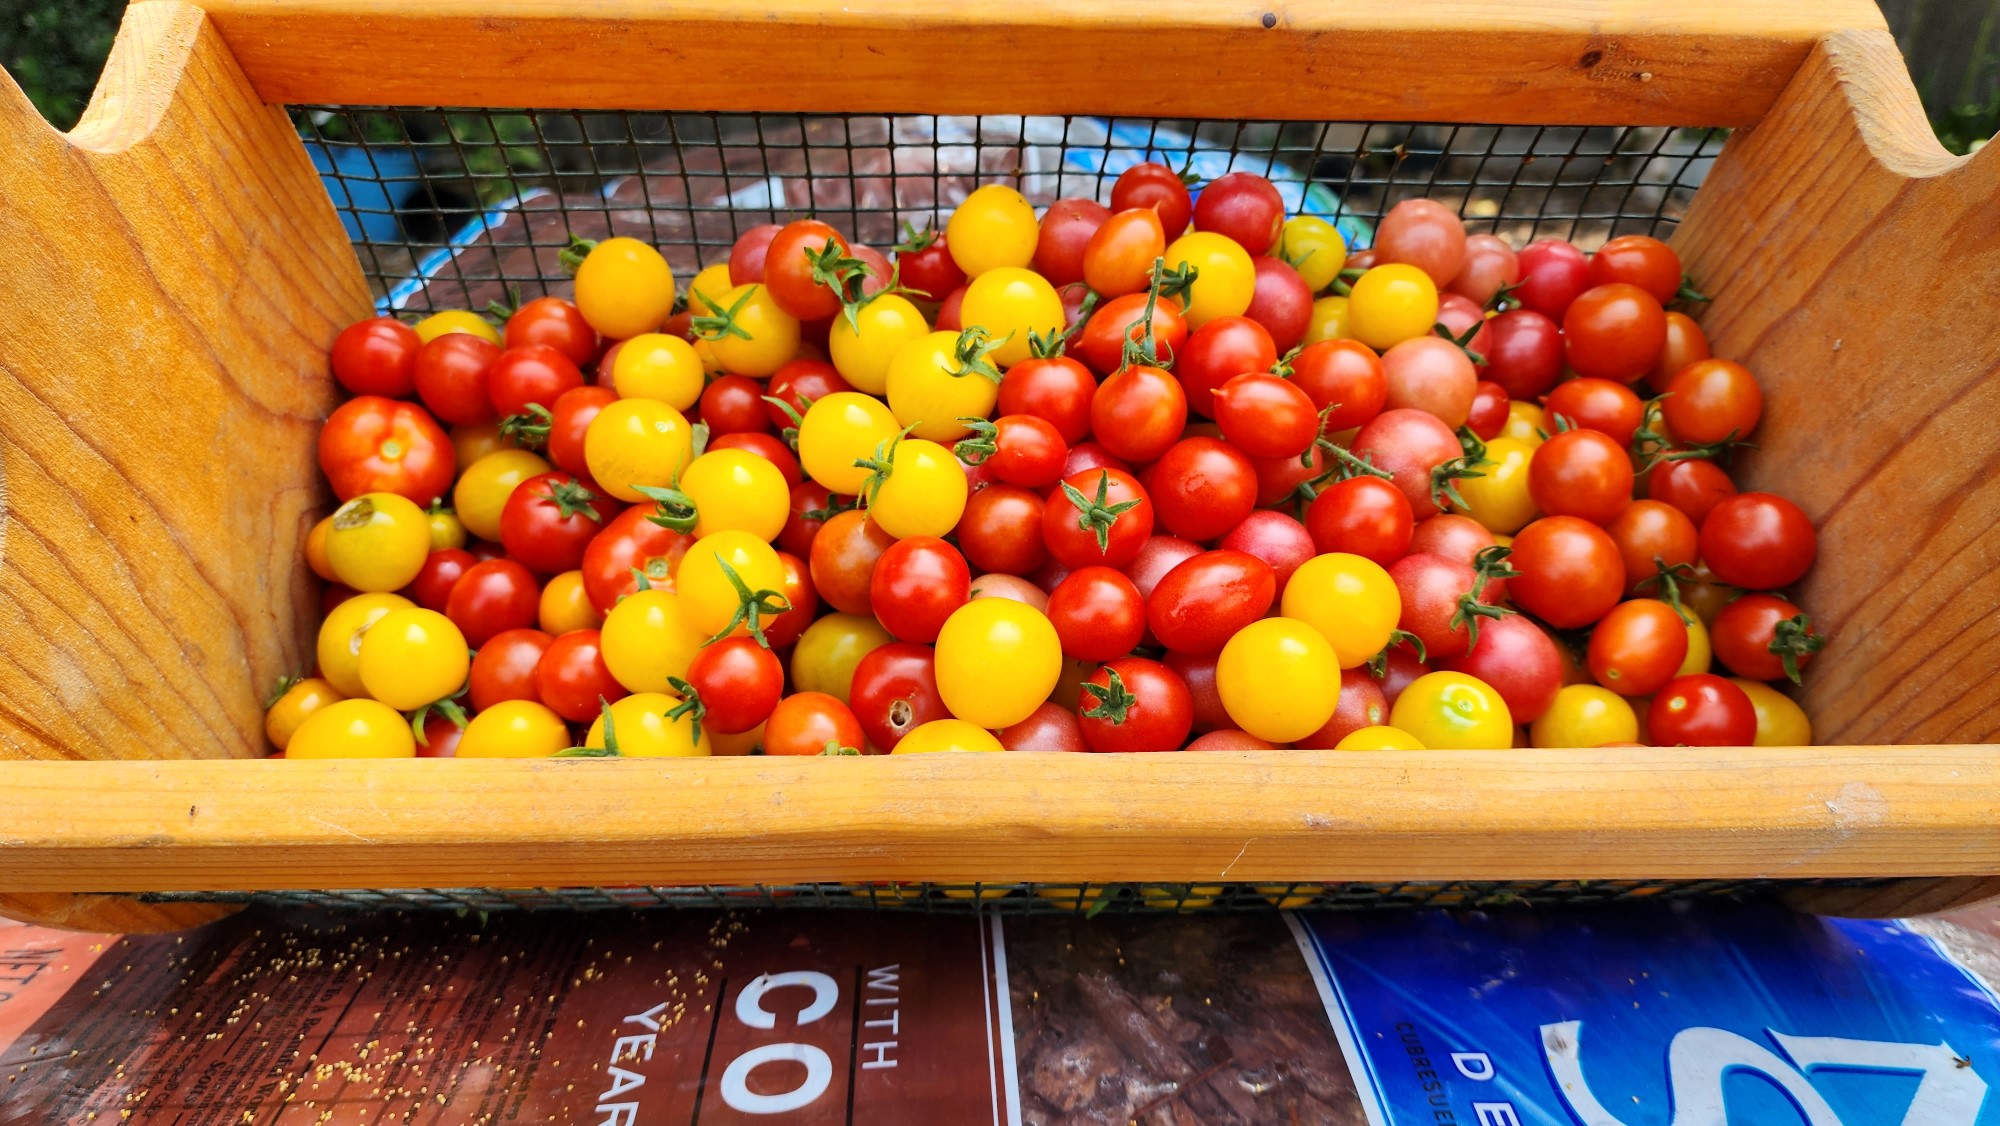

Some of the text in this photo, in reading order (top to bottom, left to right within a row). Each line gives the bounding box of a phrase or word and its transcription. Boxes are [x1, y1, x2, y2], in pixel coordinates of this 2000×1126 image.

[0, 947, 64, 985] NET
[862, 964, 899, 1069] WITH
[595, 1001, 669, 1126] YEAR
[720, 970, 839, 1114] CO
[1396, 1021, 1457, 1126] CUBRESUE
